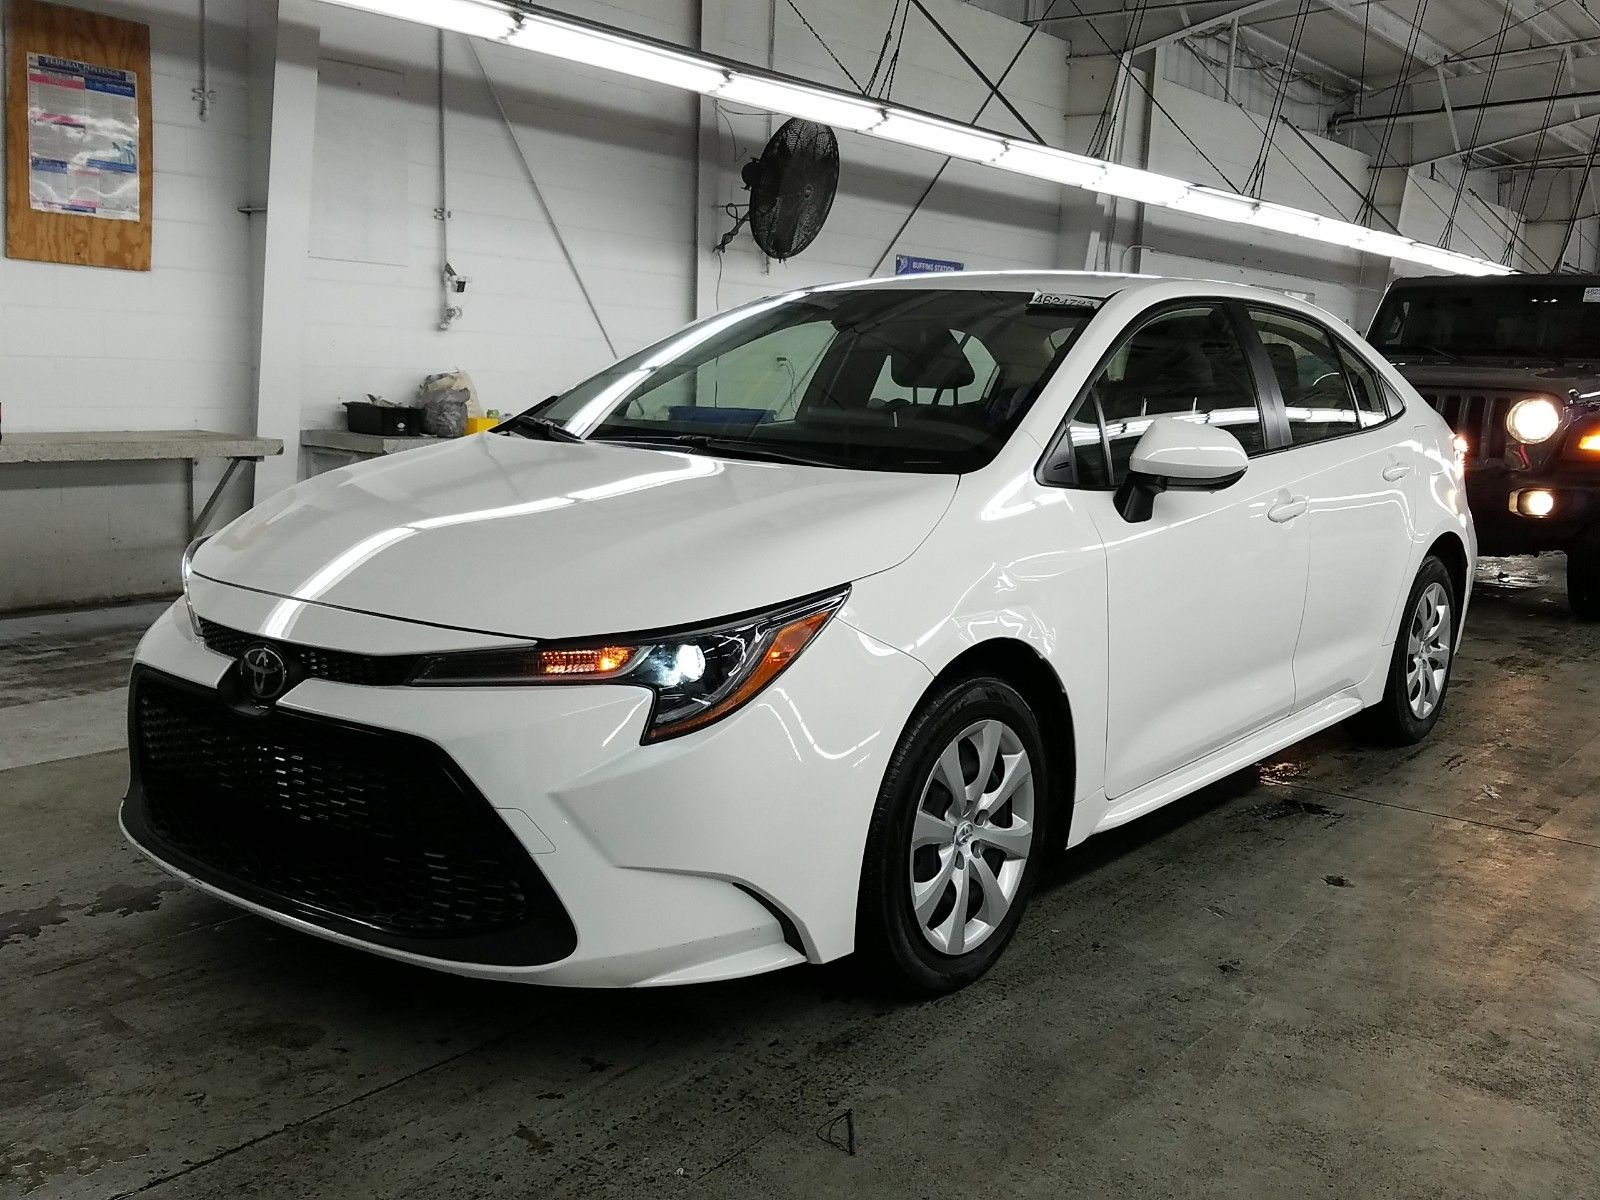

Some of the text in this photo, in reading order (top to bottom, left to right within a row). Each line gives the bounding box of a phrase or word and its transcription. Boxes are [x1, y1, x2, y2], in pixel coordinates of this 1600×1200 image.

[45, 57, 80, 70] FEDERAL
[912, 261, 955, 272] BUFFING STATION
